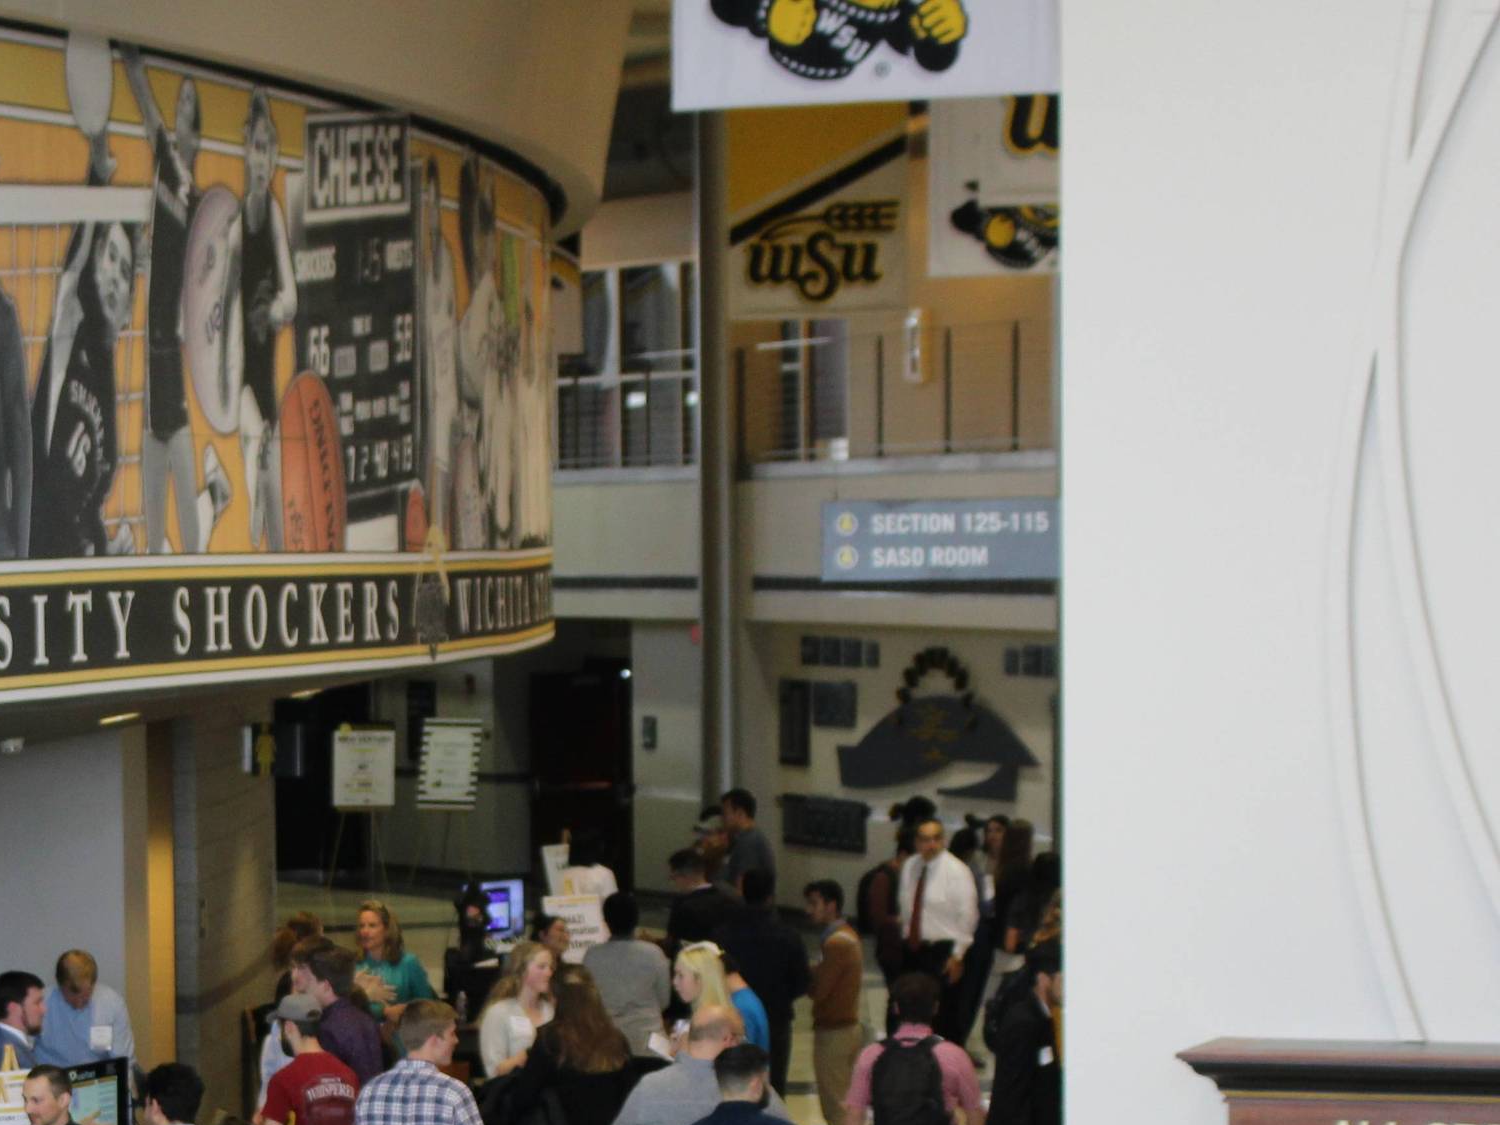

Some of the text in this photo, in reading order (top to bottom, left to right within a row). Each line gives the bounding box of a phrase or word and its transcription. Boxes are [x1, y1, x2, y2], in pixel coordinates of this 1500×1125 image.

[313, 125, 402, 208] CHEESE
[871, 510, 1049, 535] SECTION 125-115
[929, 546, 989, 568] ROOM
[172, 579, 400, 656] SHOCKERS
